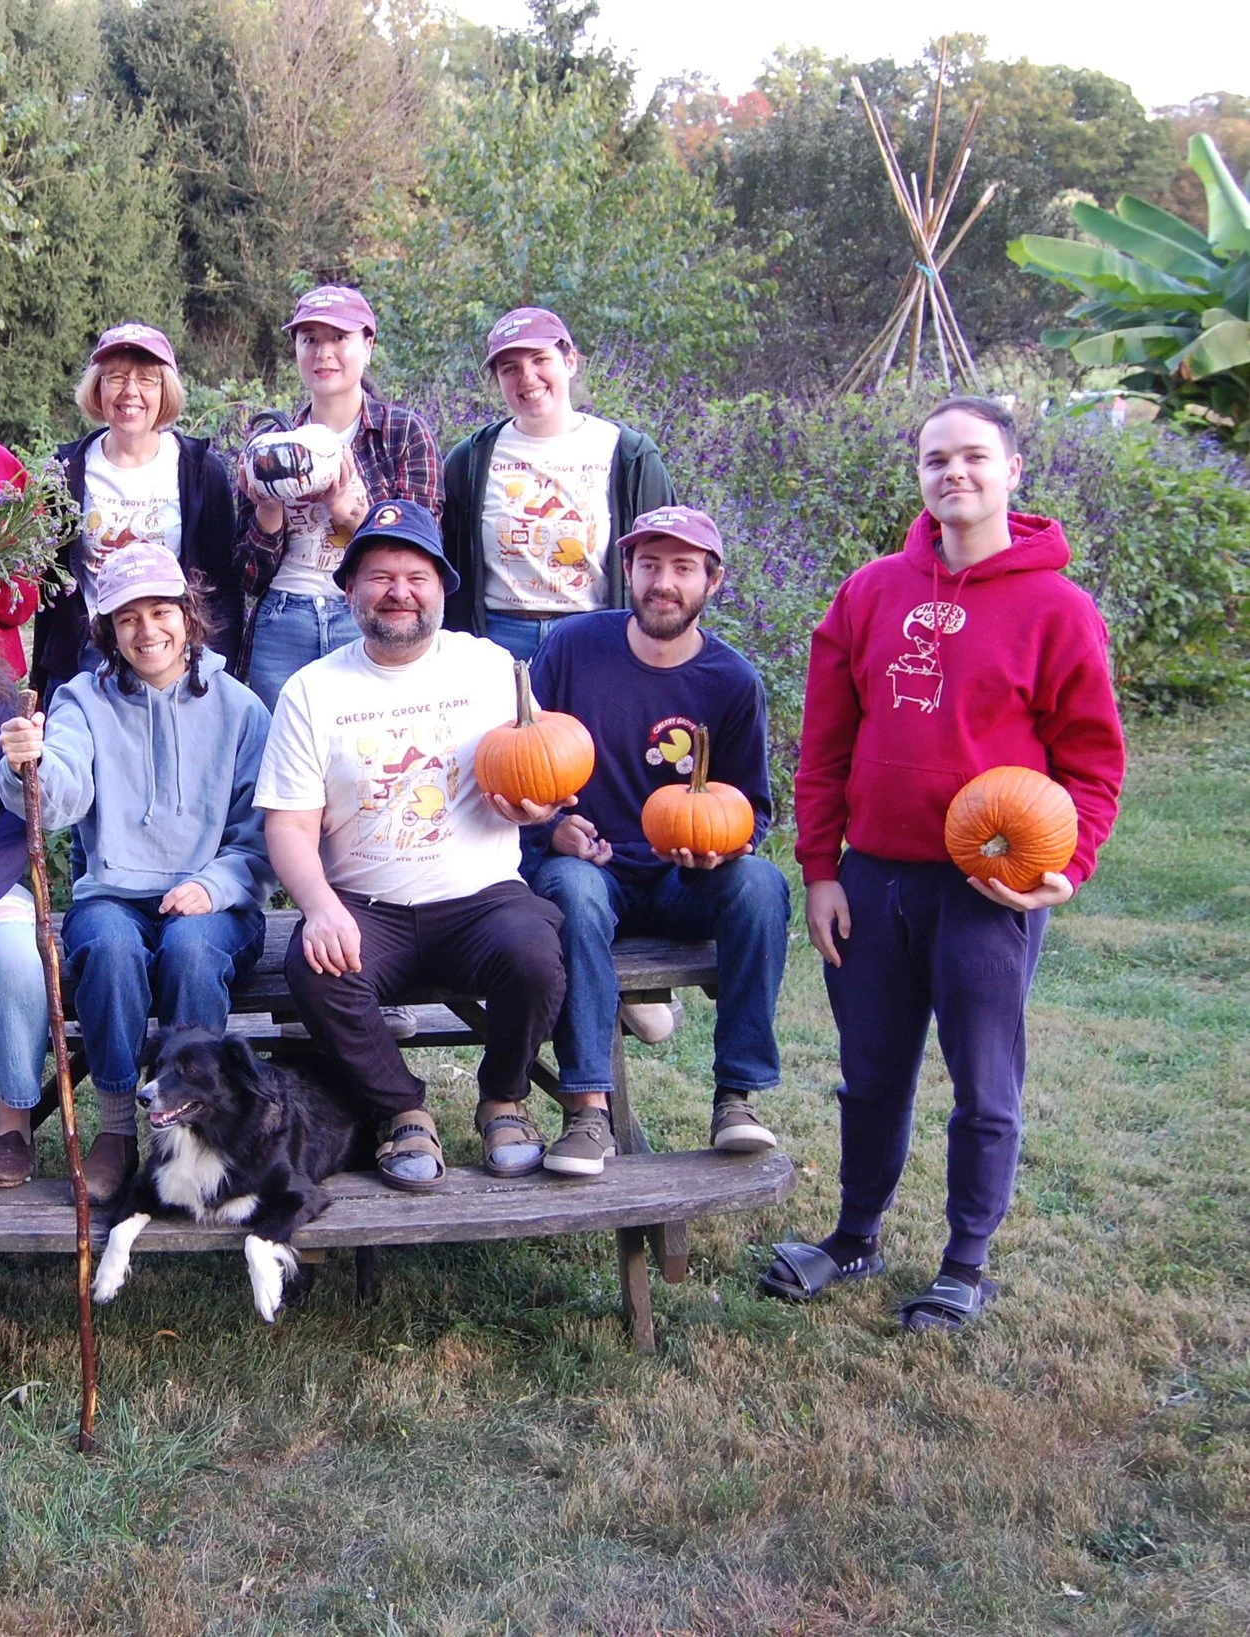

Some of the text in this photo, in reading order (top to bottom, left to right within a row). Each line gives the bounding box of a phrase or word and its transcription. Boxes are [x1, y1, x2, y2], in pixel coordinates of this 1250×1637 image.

[336, 699, 469, 726] CHERRY GROVE FARM
